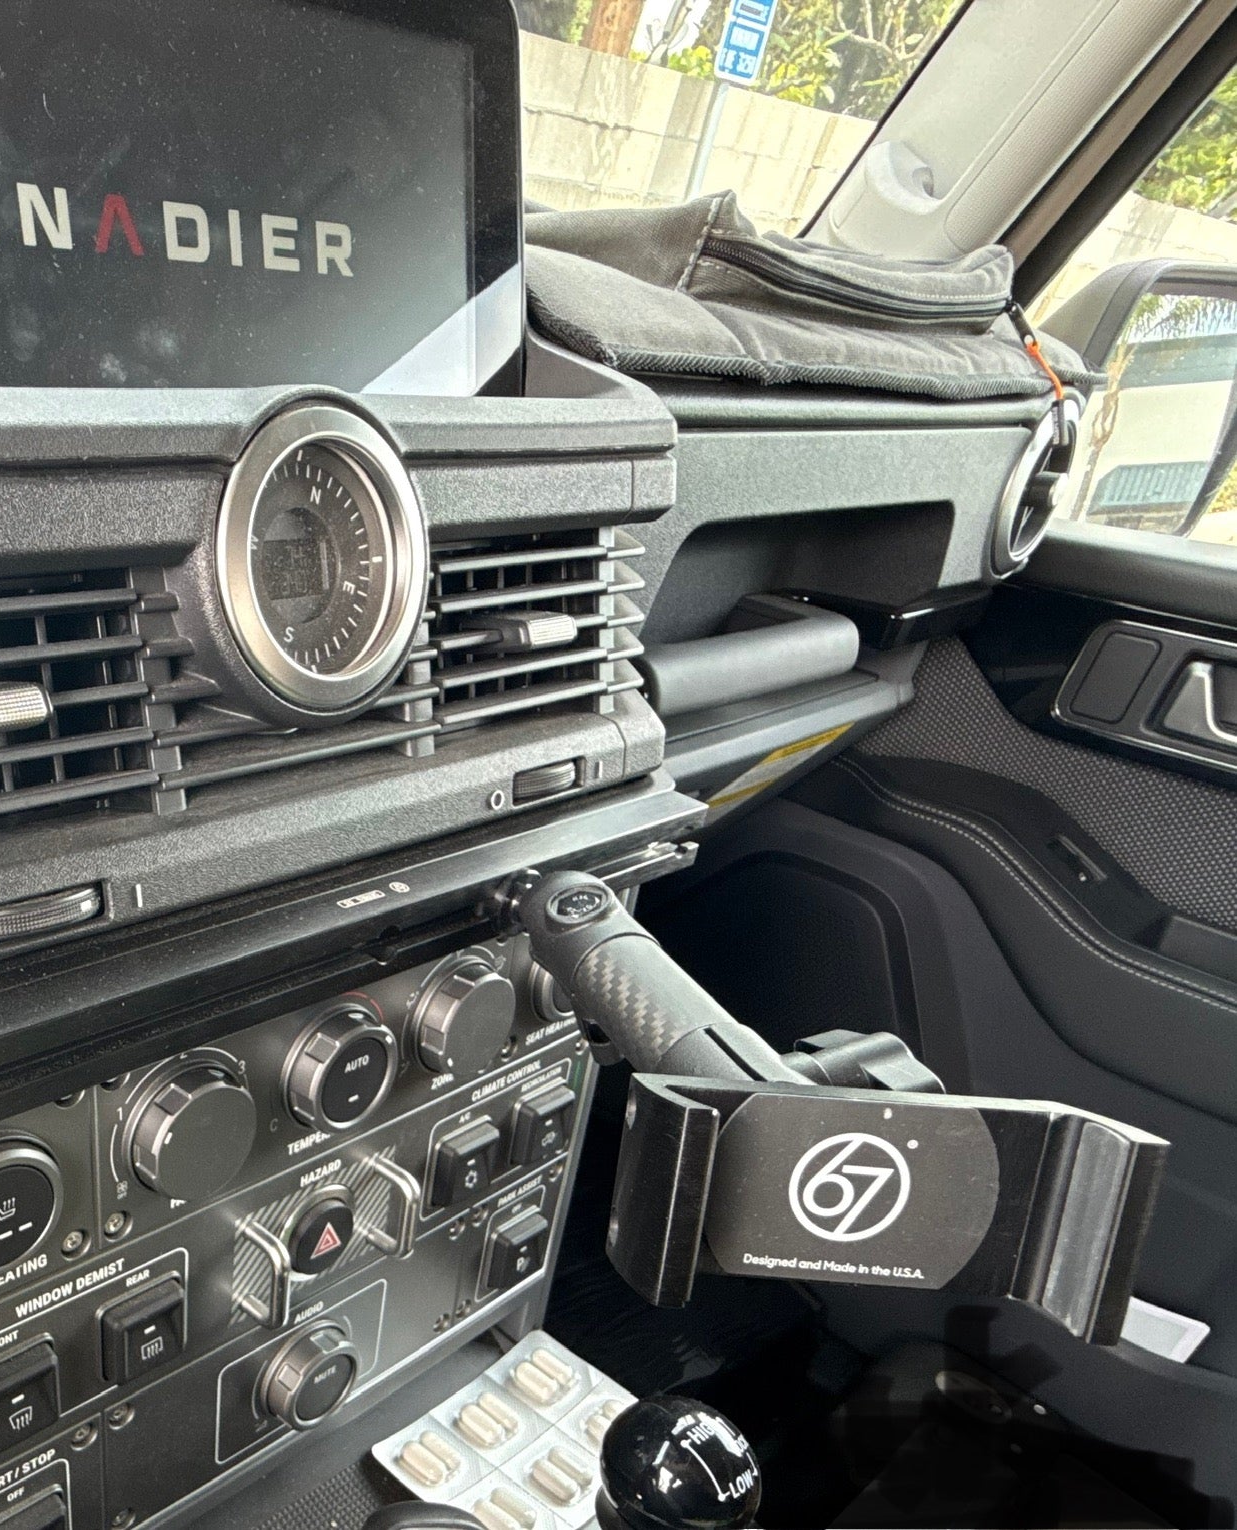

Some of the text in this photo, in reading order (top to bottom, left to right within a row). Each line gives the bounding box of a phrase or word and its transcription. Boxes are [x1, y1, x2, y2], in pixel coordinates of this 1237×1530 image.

[310, 485, 321, 505] N
[342, 581, 357, 593] E
[283, 626, 295, 643] S
[238, 1060, 246, 1075] 3
[344, 1054, 370, 1074] AUTO
[472, 1060, 541, 1102] CLIMATE CONTROL
[117, 1107, 123, 1121] 1
[300, 1159, 342, 1188] HAZARD
[497, 1174, 543, 1208] PARK ASSIST
[803, 1137, 895, 1236] 67
[743, 1253, 925, 1280] Designed and Made in the U.S.A.
[15, 1257, 125, 1318] WINDOW DEMIST
[125, 1269, 150, 1287] REAR
[294, 1301, 324, 1324] AUDIO
[313, 1364, 337, 1385] MUTE
[21, 1448, 56, 1475] STOP
[6, 1486, 26, 1502] OFF
[729, 1469, 754, 1499] LOW
